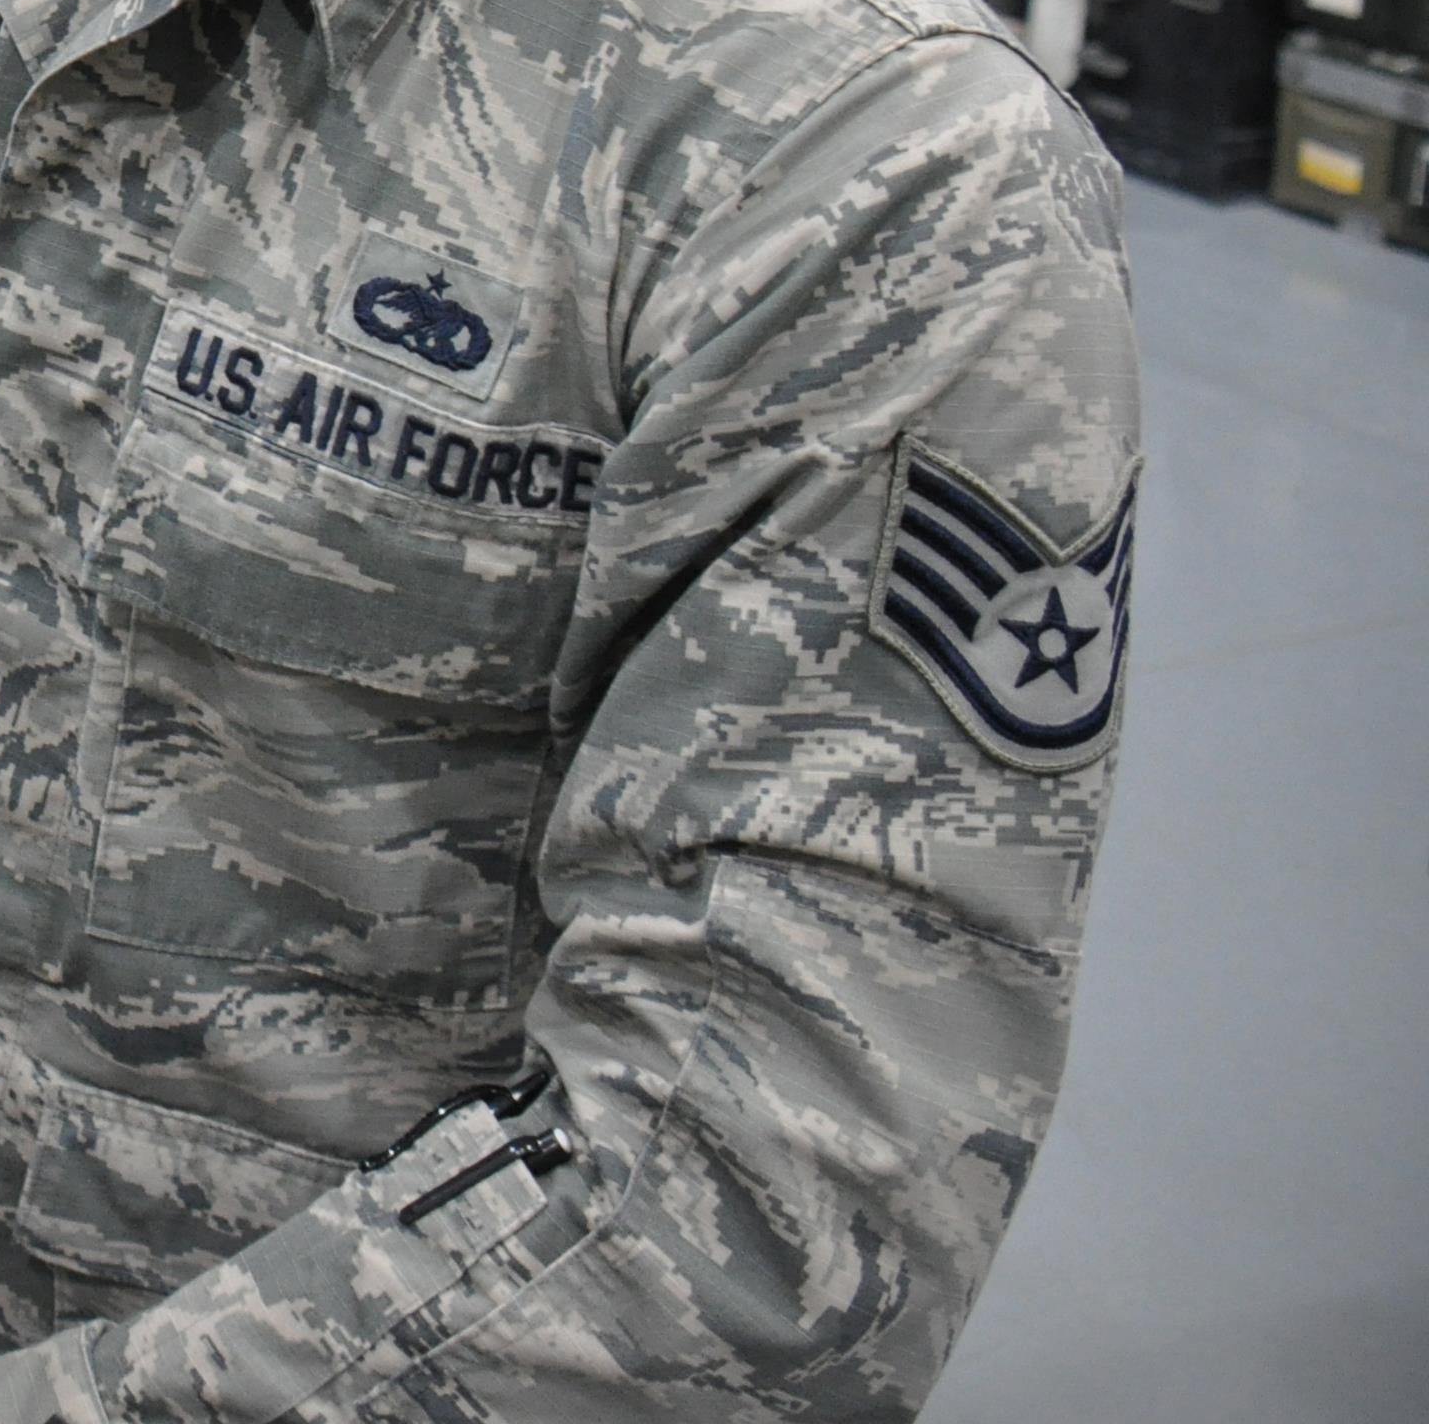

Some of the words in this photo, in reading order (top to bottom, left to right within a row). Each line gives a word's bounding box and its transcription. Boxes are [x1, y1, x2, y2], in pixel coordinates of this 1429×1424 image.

[176, 327, 264, 419] U.S.
[274, 372, 383, 467] AIR
[391, 414, 606, 513] FORCE
